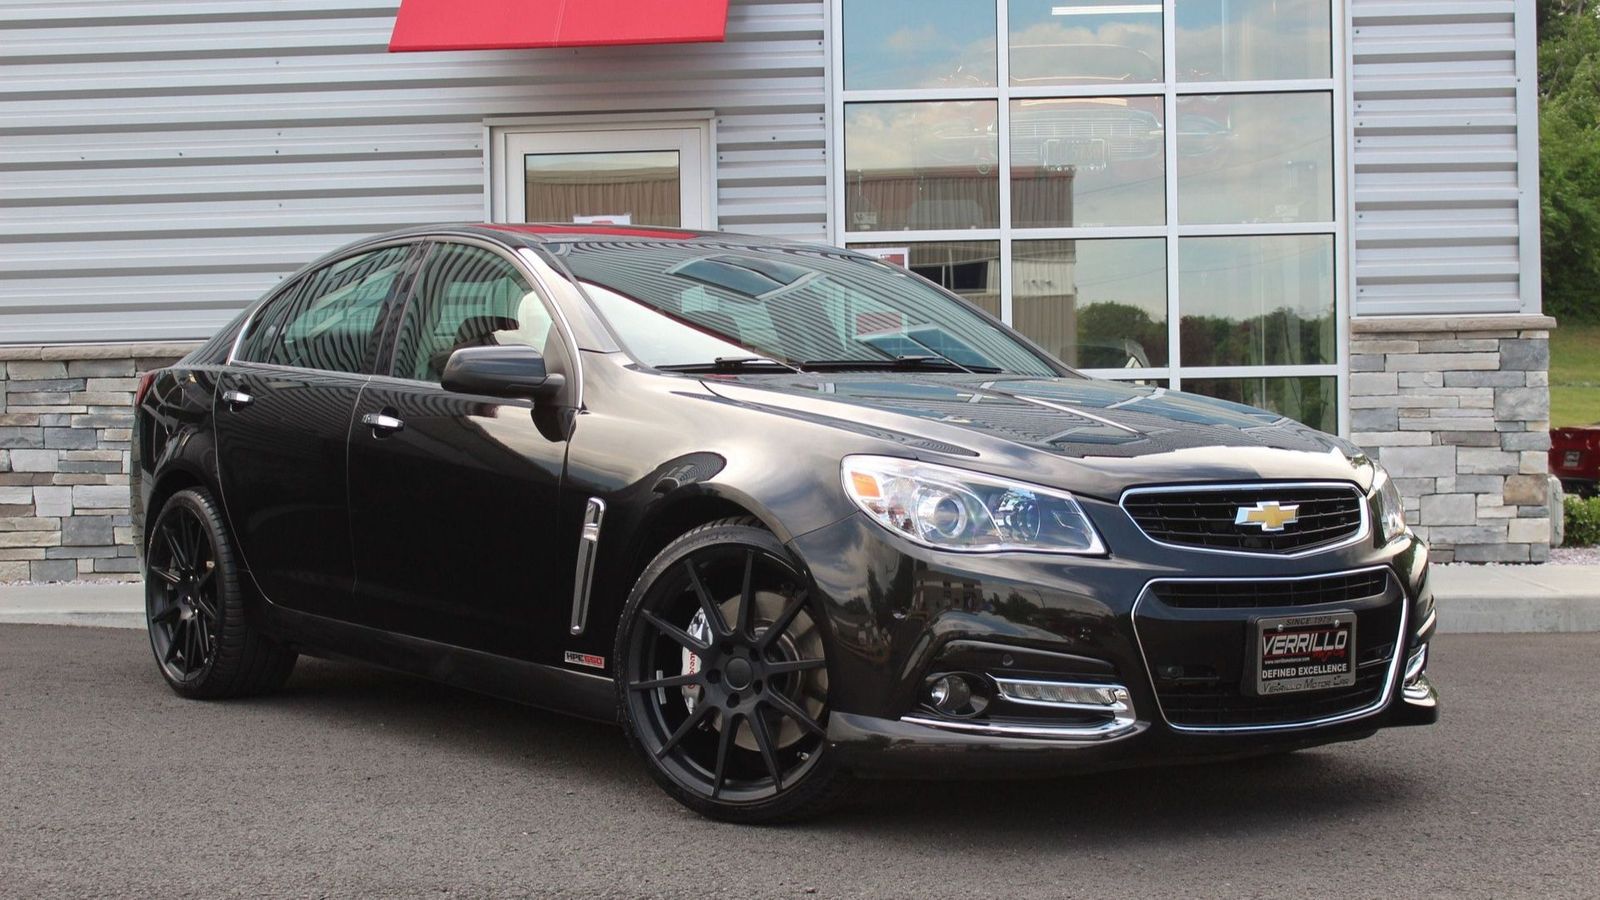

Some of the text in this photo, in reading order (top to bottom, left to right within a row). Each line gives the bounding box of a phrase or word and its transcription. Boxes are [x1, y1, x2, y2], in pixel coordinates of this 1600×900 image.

[1286, 617, 1311, 625] SINCE
[1262, 630, 1348, 656] VERRILLO
[1262, 663, 1348, 679] DEFINED EXCELLENCE
